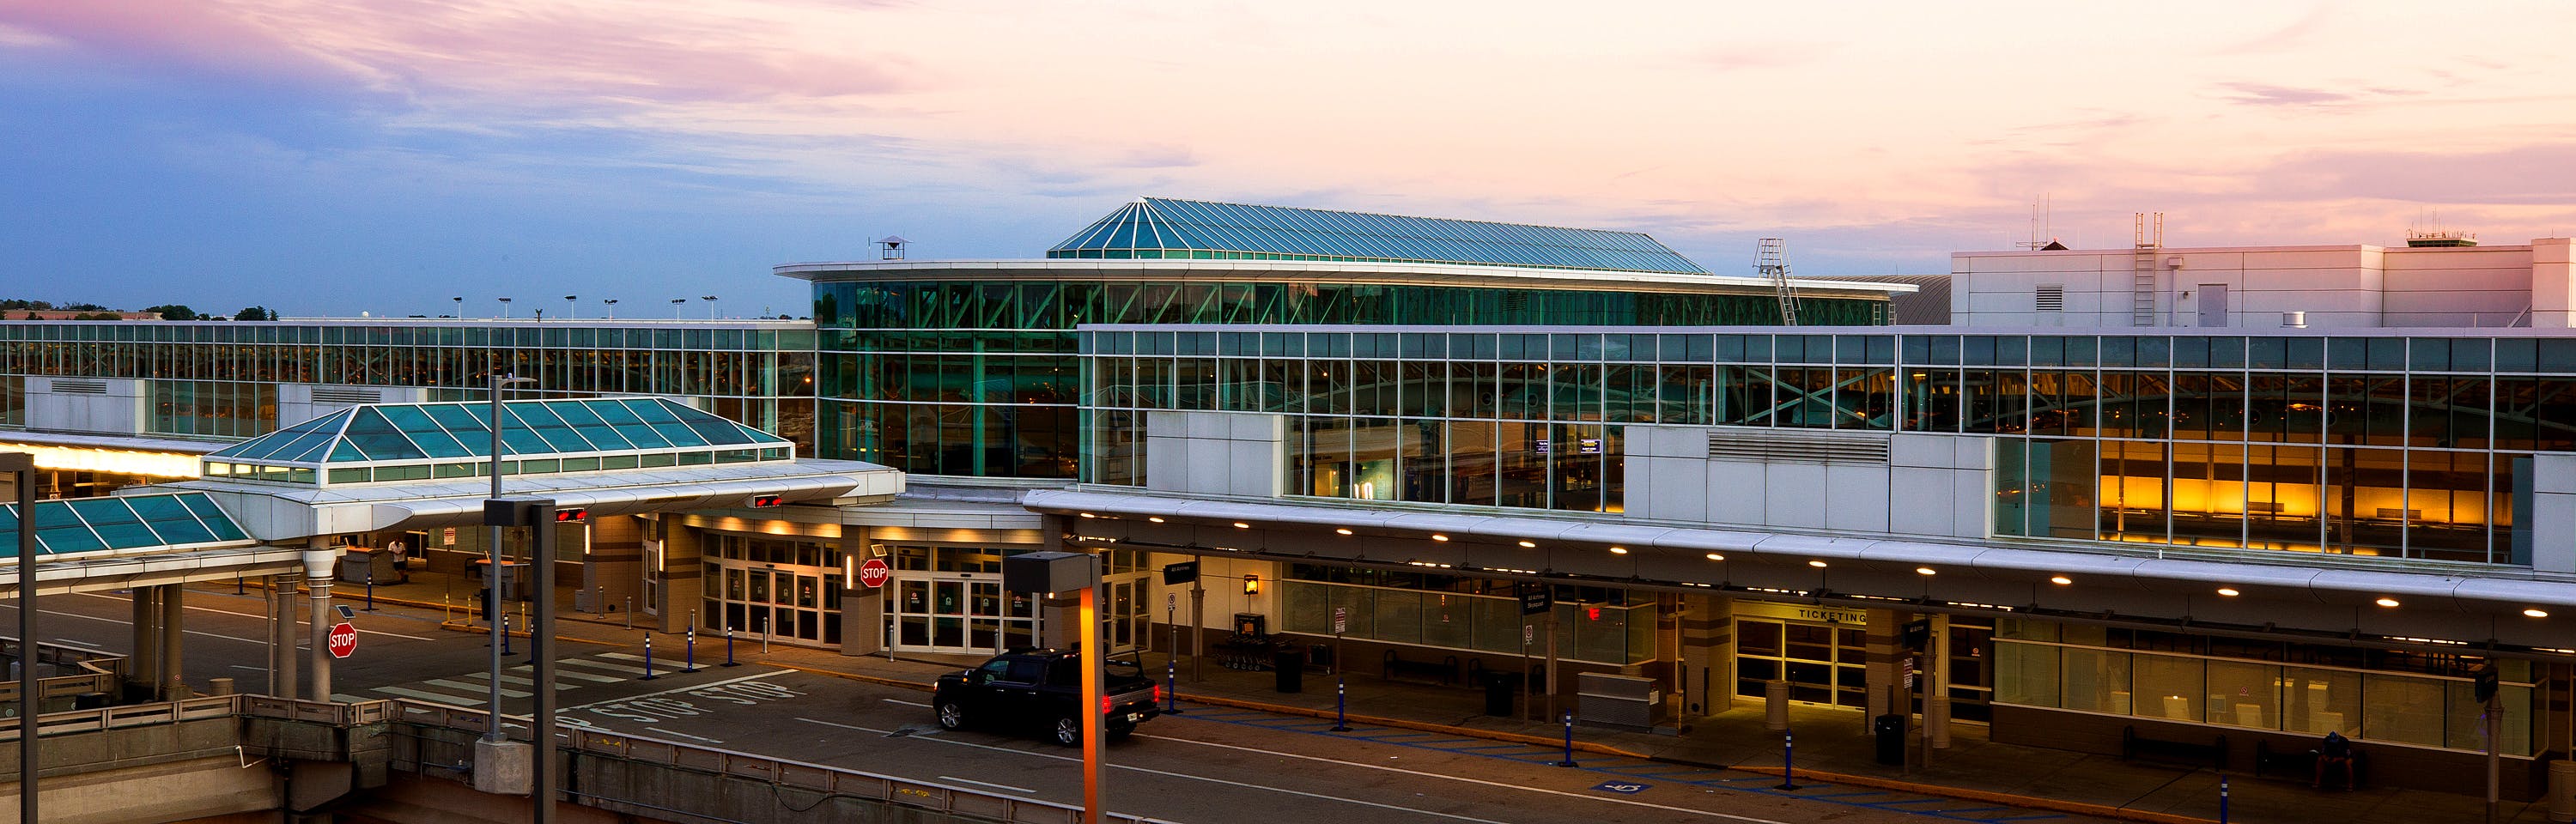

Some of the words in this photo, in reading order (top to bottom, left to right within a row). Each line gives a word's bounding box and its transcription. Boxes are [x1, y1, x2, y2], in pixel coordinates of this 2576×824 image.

[862, 567, 886, 579] STOP
[1799, 609, 1867, 621] TICKETING
[331, 633, 355, 647] STOP
[689, 682, 808, 705] STOP
[589, 698, 714, 723] STOP
